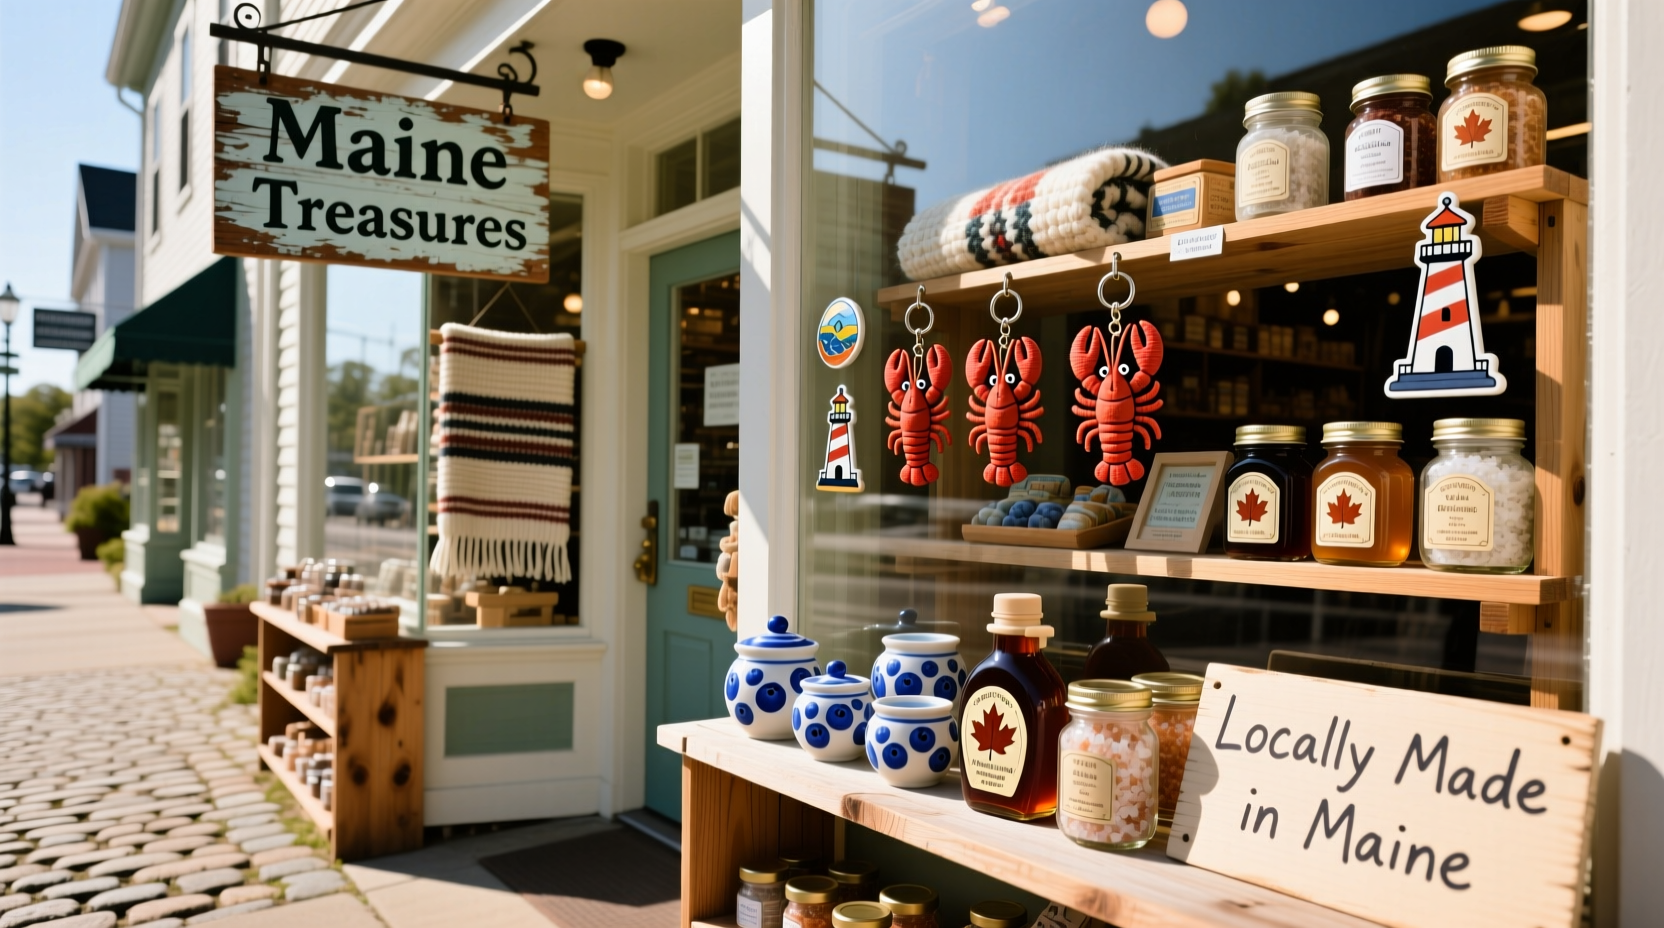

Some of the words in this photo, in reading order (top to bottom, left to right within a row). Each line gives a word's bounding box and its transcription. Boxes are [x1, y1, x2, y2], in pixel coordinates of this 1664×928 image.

[263, 97, 507, 190] Maine
[252, 177, 527, 251] Treasures
[1215, 694, 1374, 792] Locally
[1394, 733, 1548, 814] Made
[1240, 787, 1279, 839] in
[1303, 798, 1472, 890] Maine
